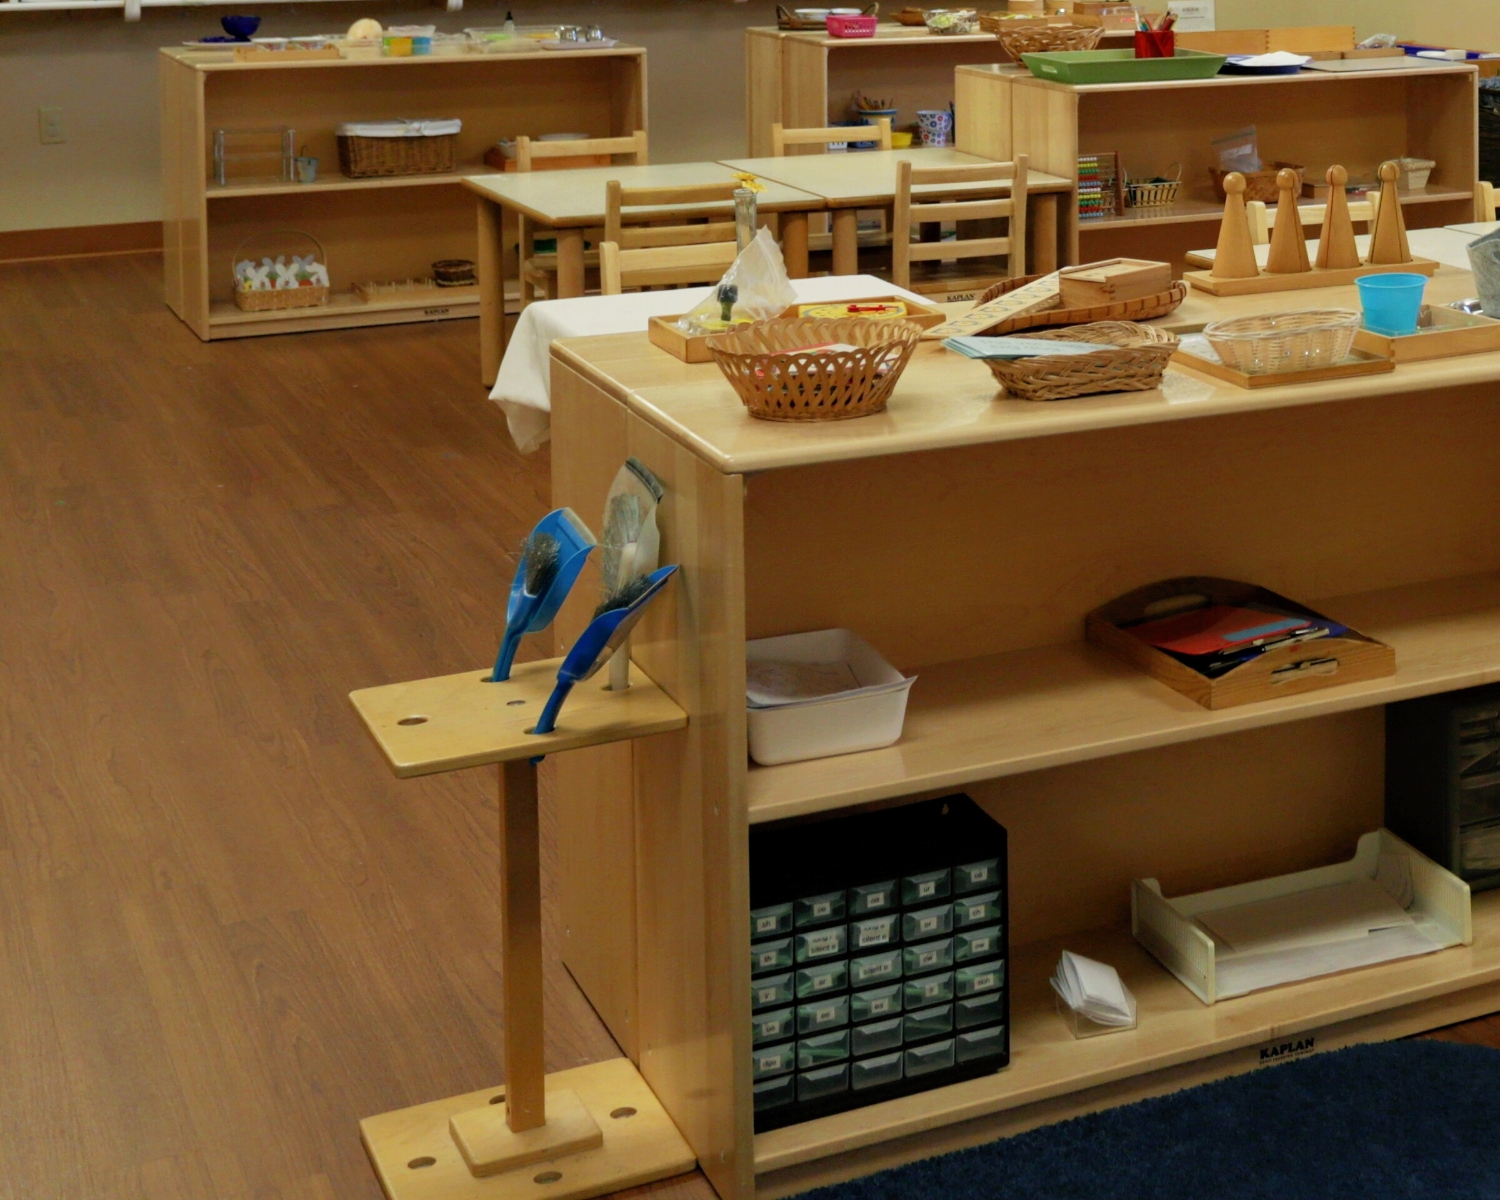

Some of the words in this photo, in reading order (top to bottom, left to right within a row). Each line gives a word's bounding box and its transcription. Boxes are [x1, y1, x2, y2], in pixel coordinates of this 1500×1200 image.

[946, 294, 974, 302] KAPLAN
[811, 943, 830, 954] silent
[1260, 1037, 1315, 1060] KAPLAN
